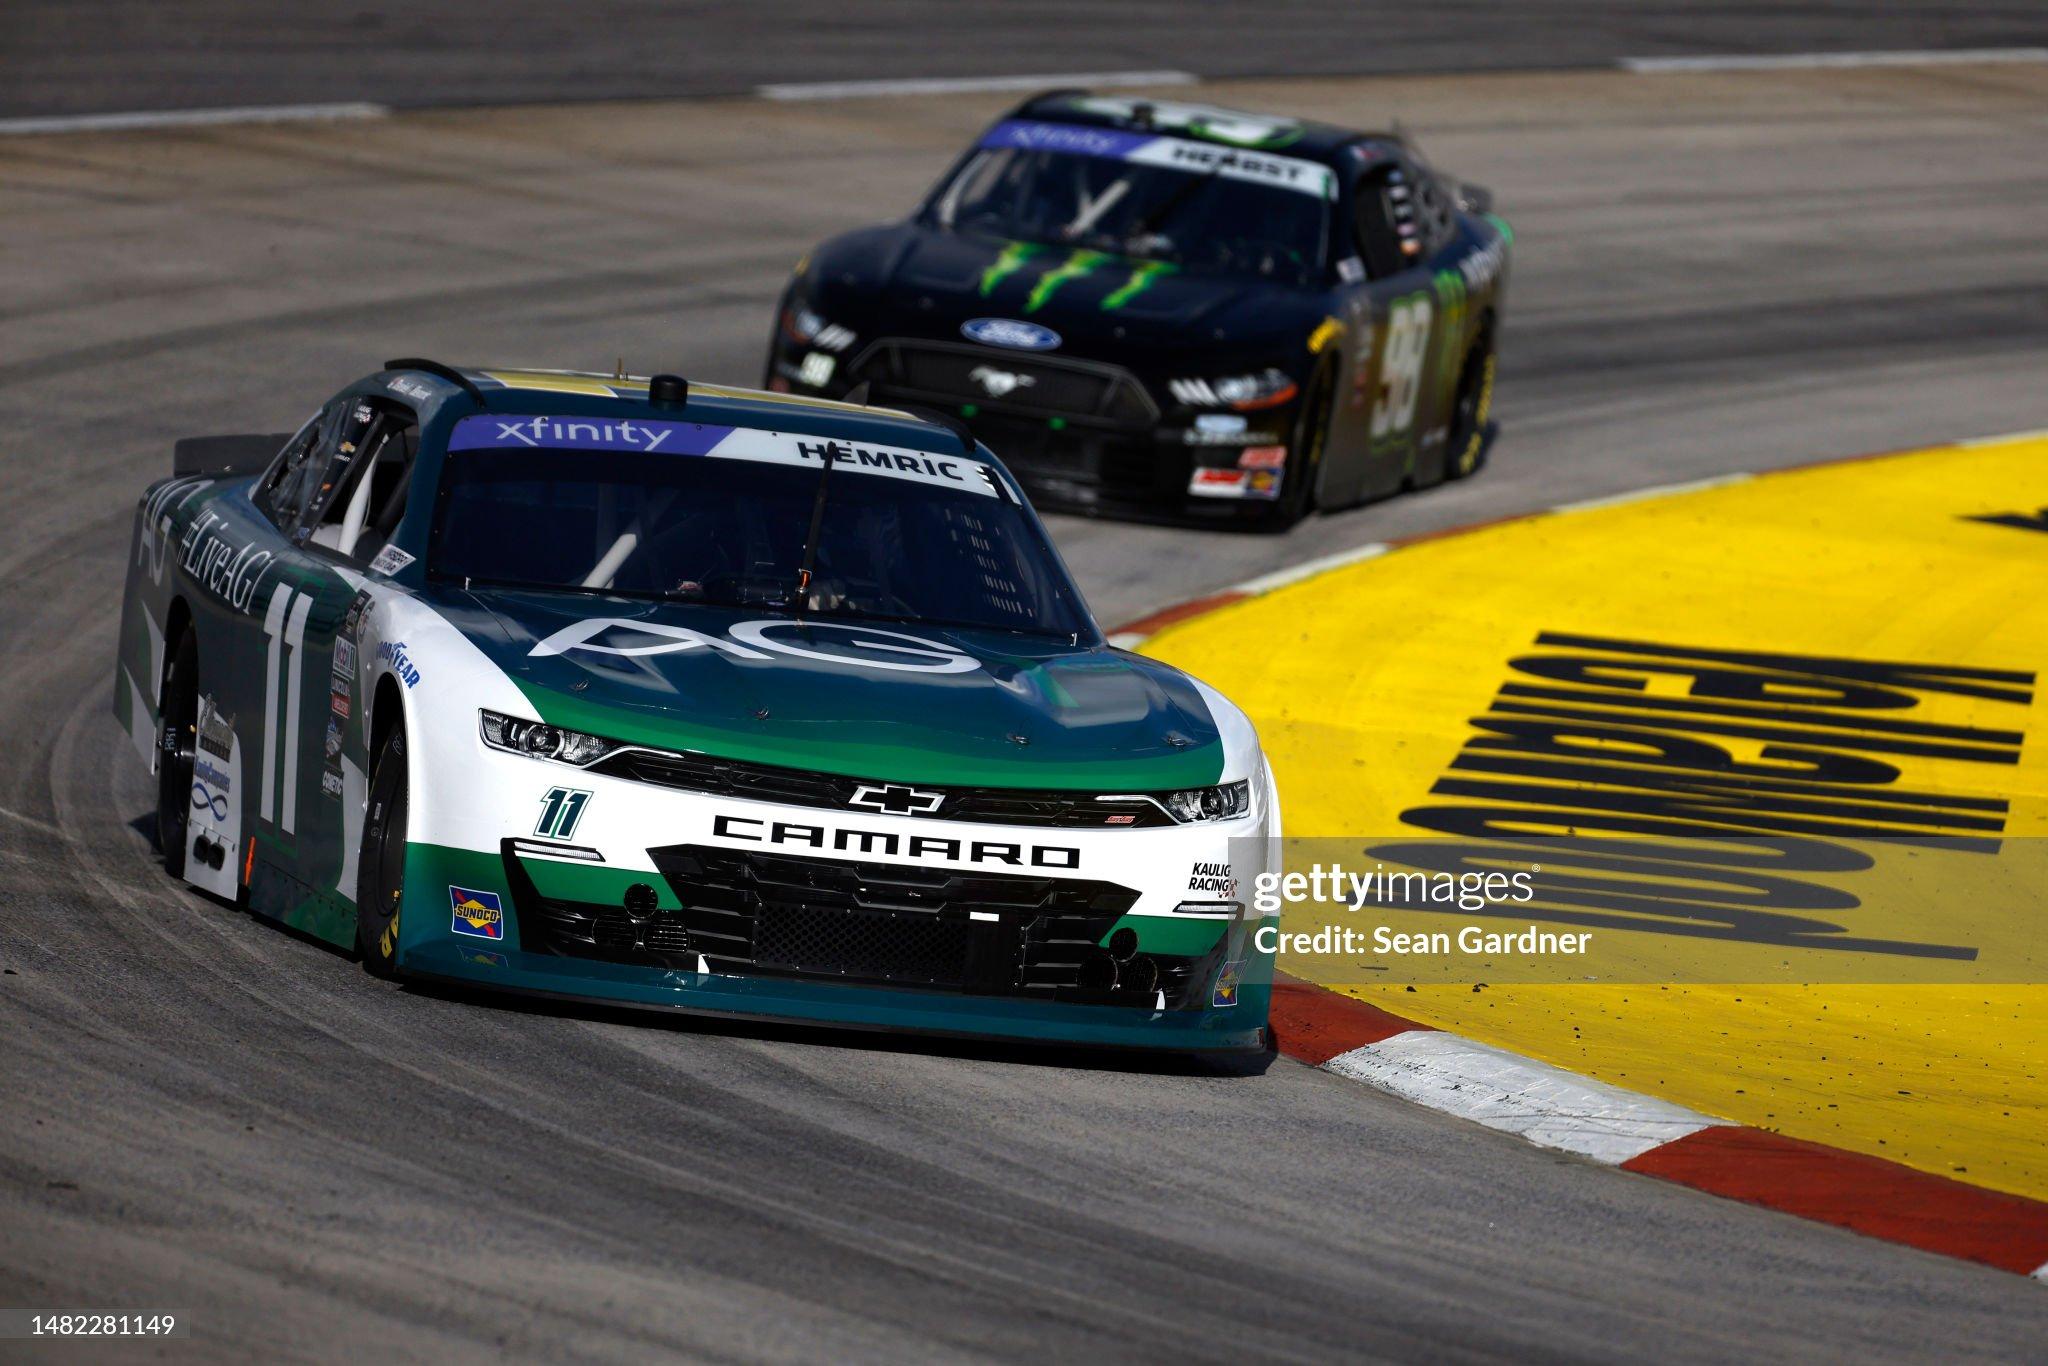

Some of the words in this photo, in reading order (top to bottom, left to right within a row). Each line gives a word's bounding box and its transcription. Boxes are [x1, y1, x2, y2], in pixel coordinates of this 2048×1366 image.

[1172, 146, 1303, 181] HERBST
[496, 416, 673, 452] xfinity
[797, 441, 964, 481] HEMRIC
[260, 582, 314, 835] 11
[533, 786, 595, 841] 11
[712, 814, 1081, 869] CAMARO
[1188, 877, 1229, 891] RACING
[1192, 862, 1232, 877] KAULIG
[456, 904, 498, 922] SUNOCO
